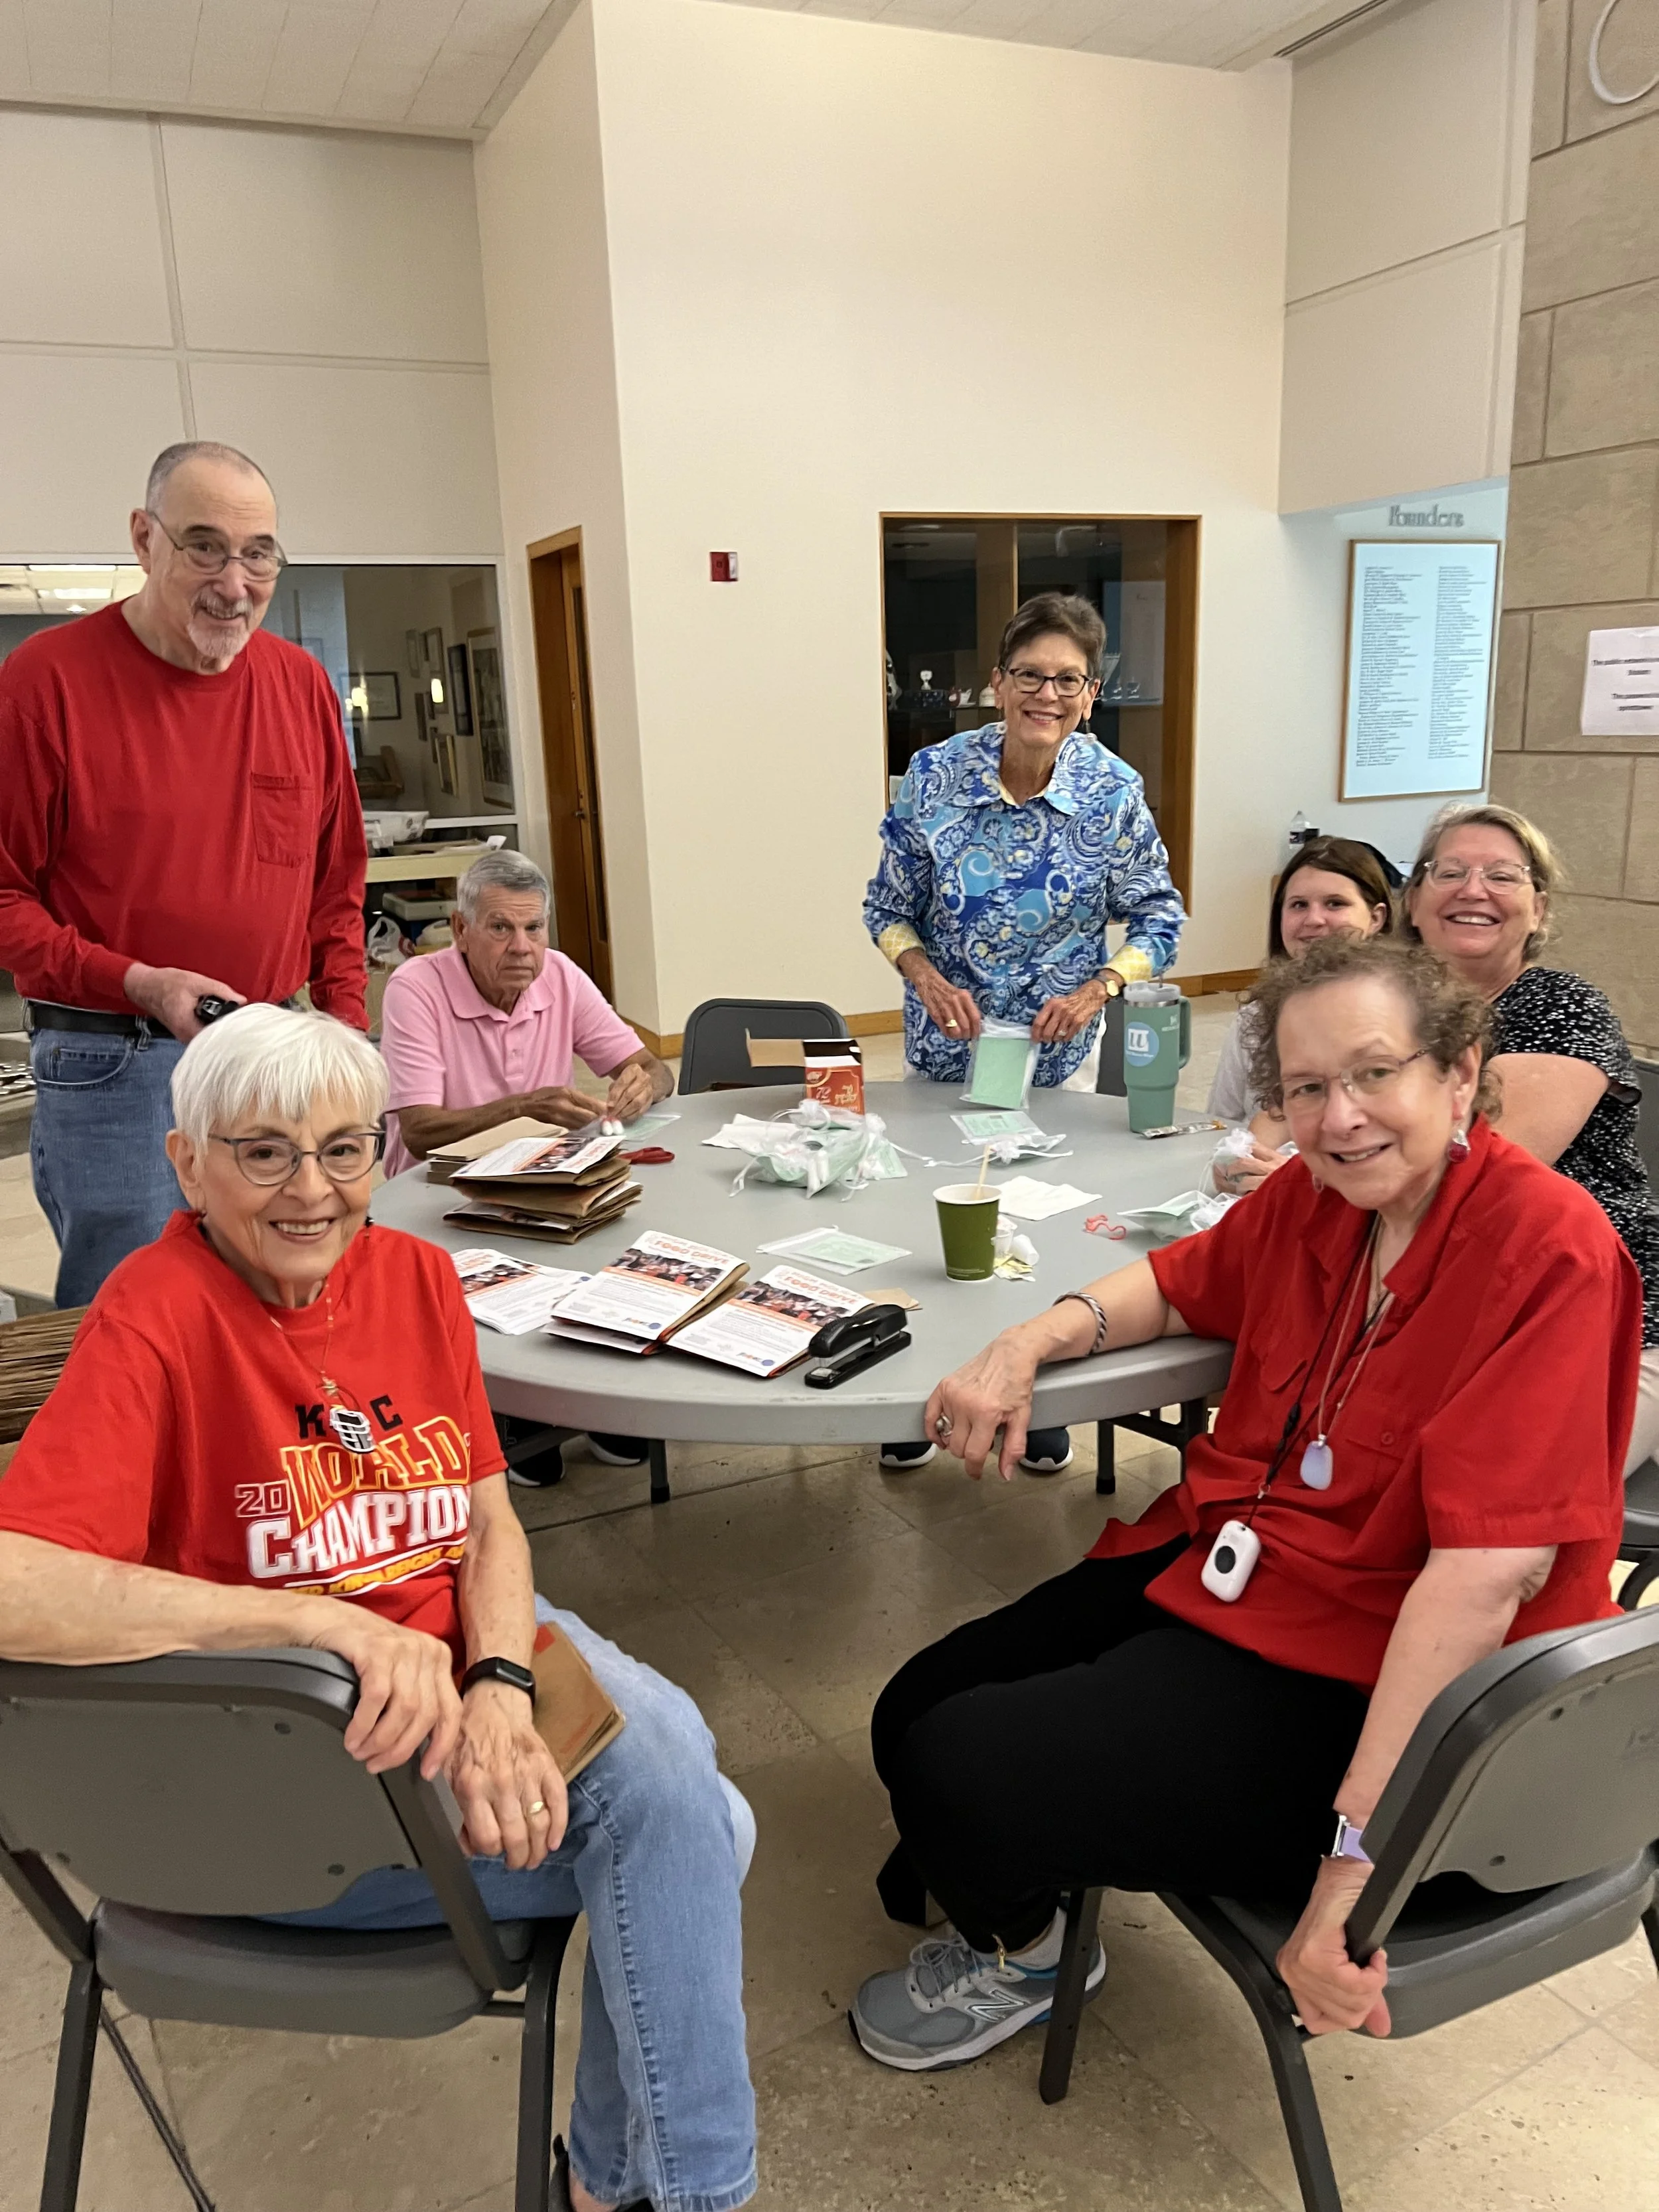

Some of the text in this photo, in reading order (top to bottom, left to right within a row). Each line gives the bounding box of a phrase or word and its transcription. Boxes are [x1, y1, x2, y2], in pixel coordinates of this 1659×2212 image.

[654, 1240, 690, 1254] FOOD
[691, 1251, 729, 1265] DRIVE
[784, 1276, 818, 1291] FOOD
[819, 1290, 857, 1304] DRIVE
[296, 1395, 402, 1439] K C
